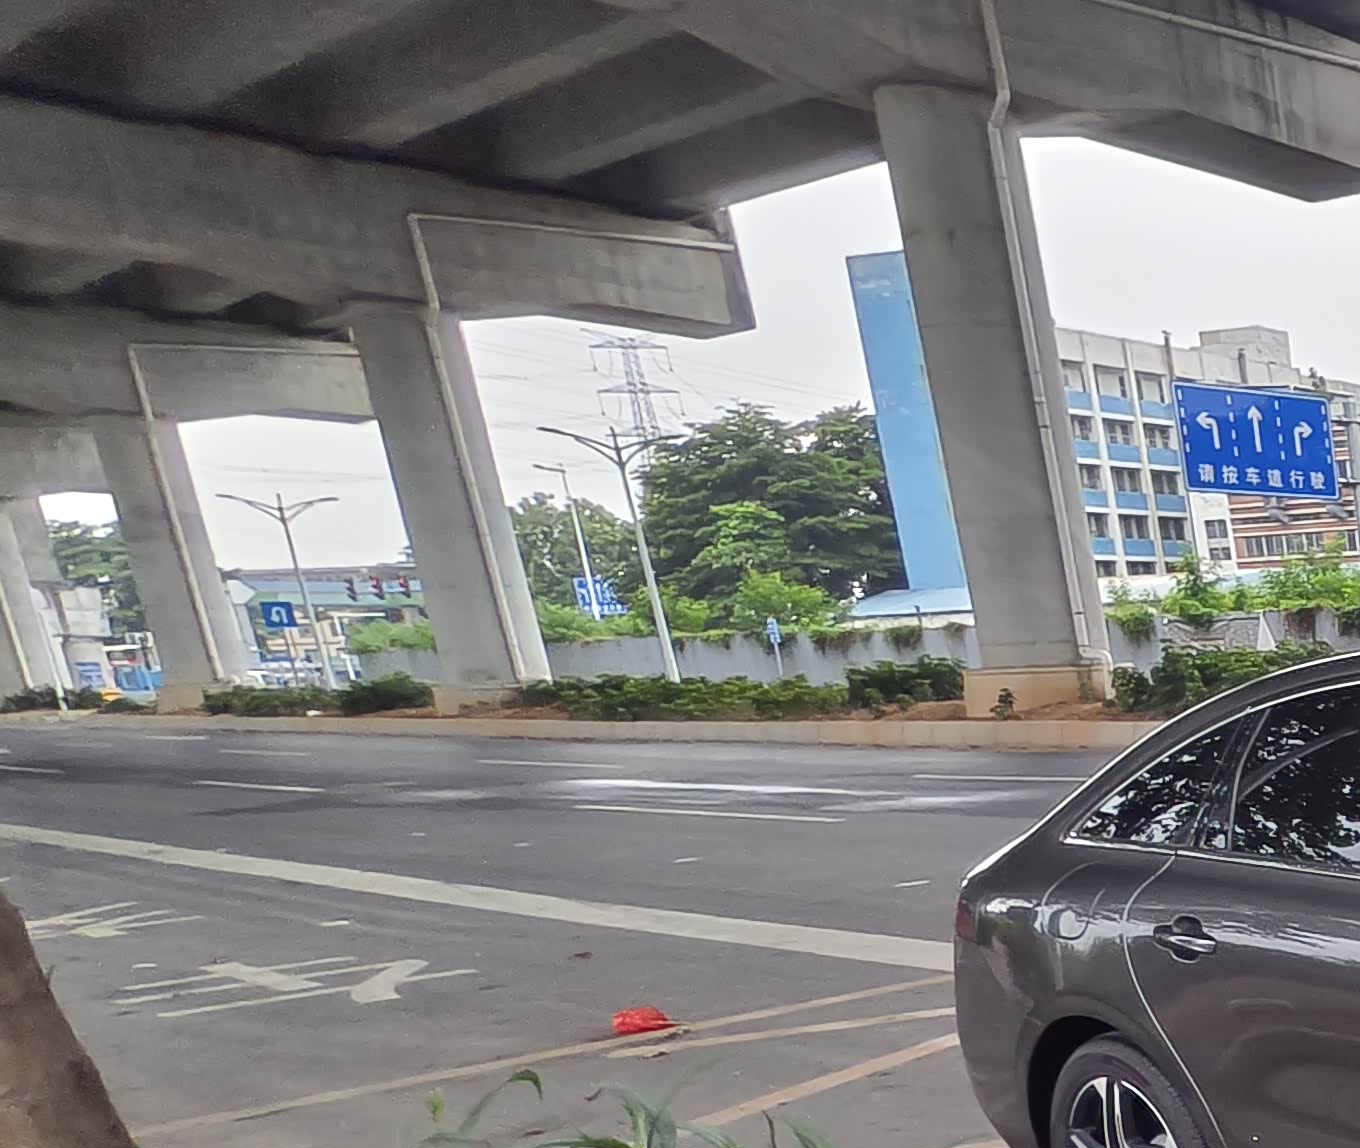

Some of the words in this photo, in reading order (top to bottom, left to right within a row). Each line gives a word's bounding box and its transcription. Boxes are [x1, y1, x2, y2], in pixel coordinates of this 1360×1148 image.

[1198, 463, 1326, 490] 请按车道行驶
